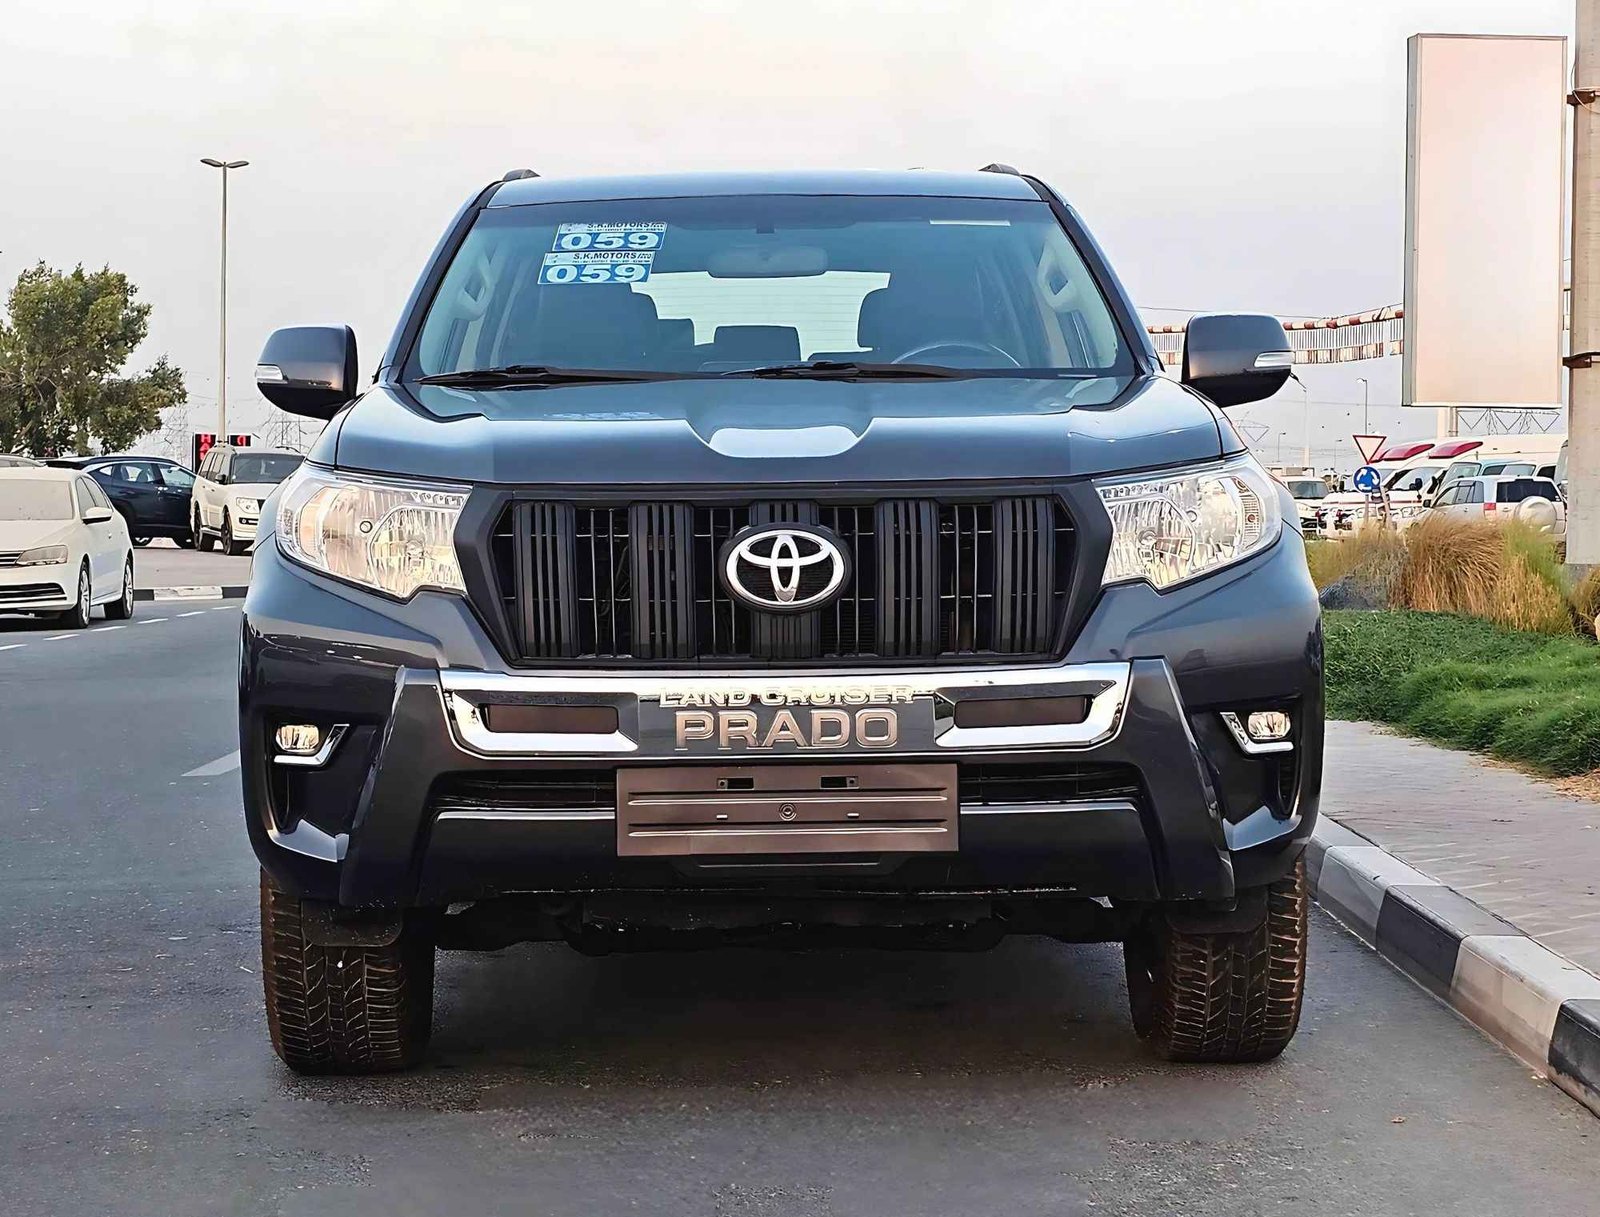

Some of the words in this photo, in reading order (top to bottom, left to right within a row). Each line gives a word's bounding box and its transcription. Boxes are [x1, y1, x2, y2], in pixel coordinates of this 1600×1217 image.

[561, 232, 659, 249] 059
[546, 264, 645, 282] 059
[659, 687, 752, 707] LAND
[758, 685, 914, 706] CRUISER
[674, 708, 898, 750] PRADO
